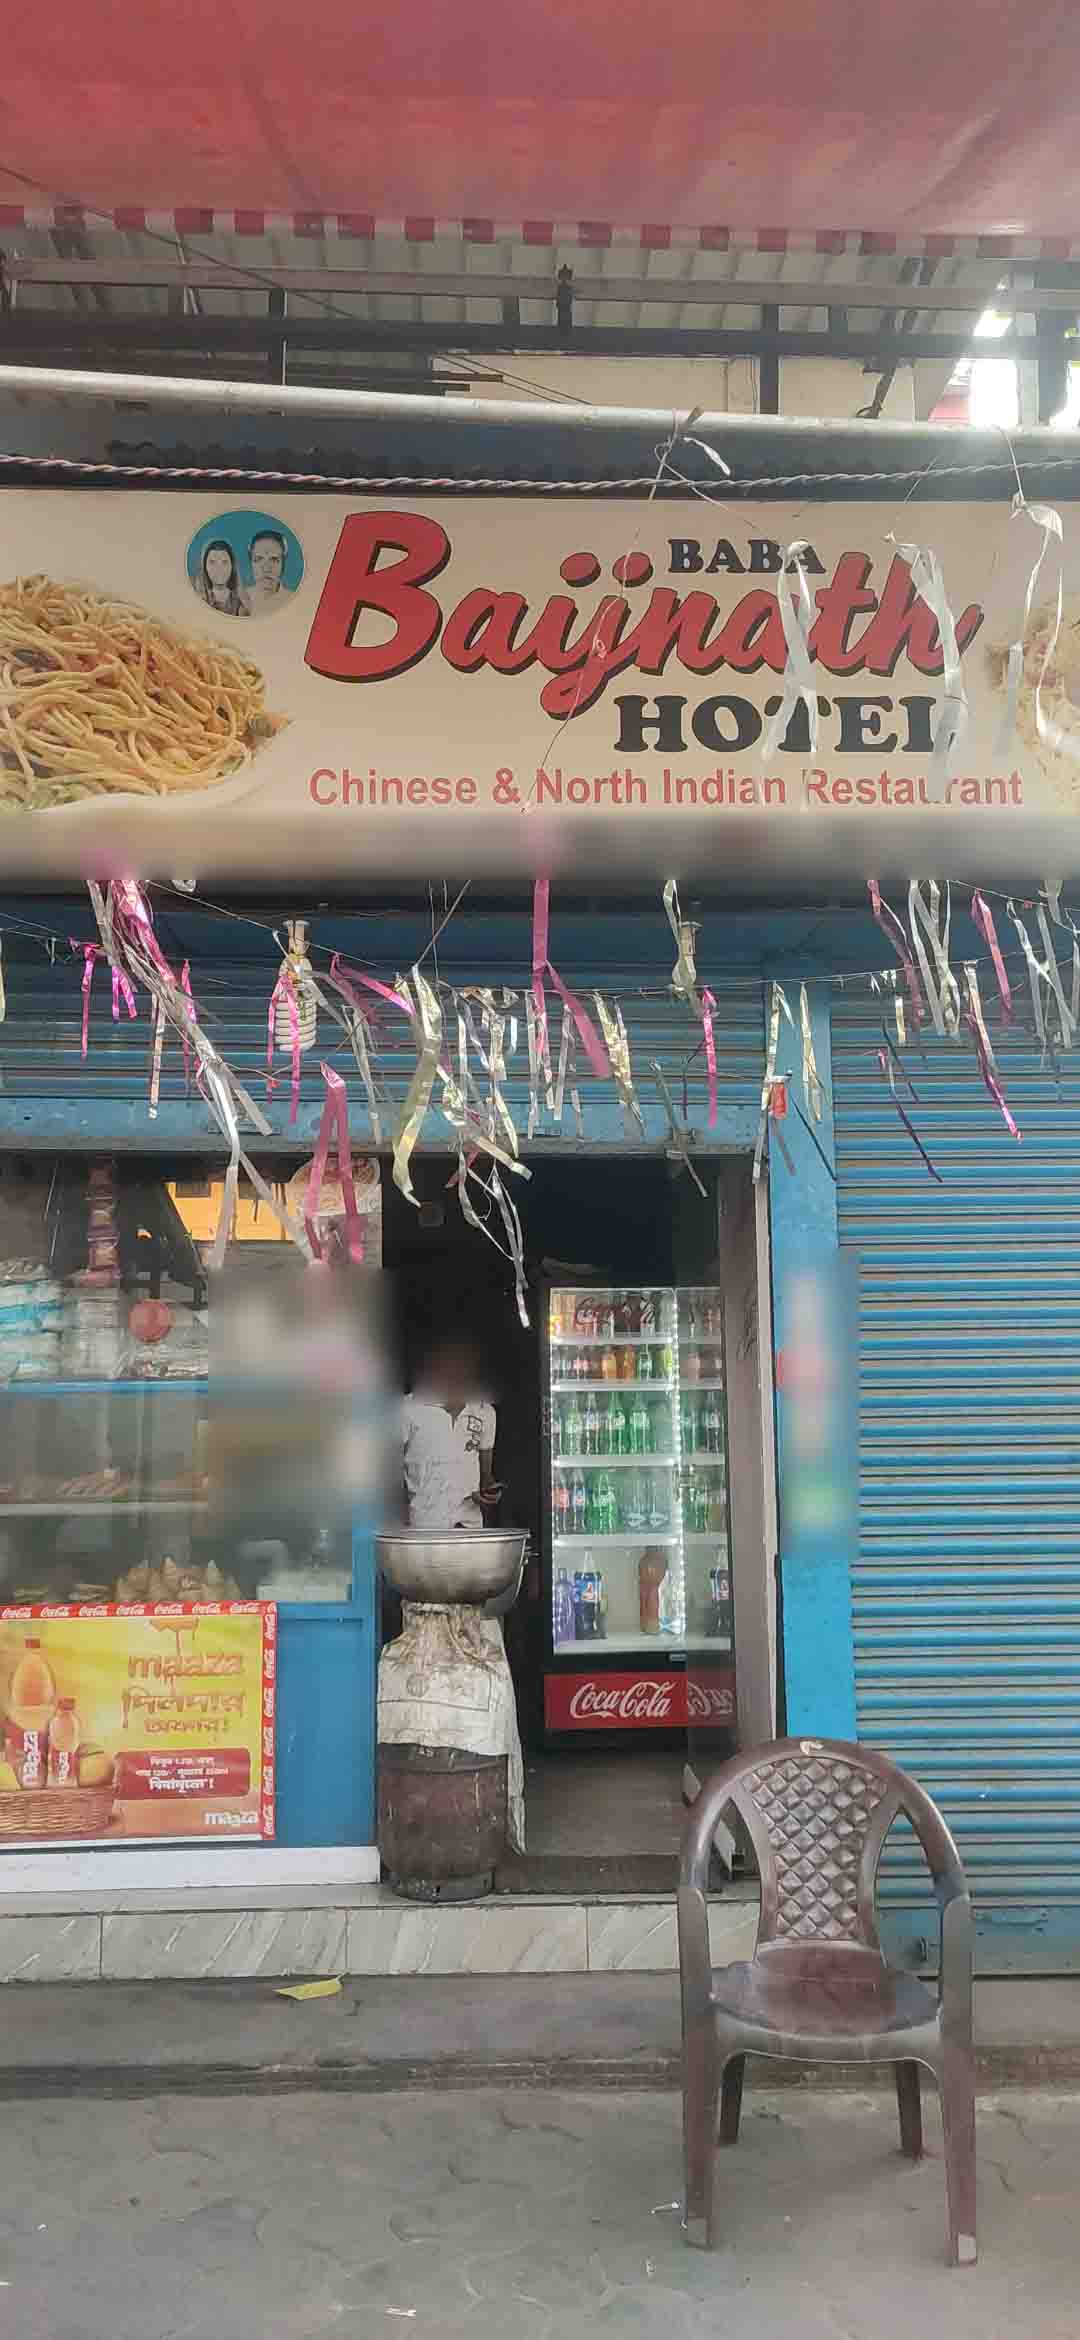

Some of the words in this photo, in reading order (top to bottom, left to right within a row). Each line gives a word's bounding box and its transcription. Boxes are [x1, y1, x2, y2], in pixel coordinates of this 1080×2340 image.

[668, 538, 826, 574] BABA
[304, 510, 985, 721] Baijnath
[309, 768, 478, 805] Chinese
[492, 768, 522, 805] &
[535, 768, 648, 805] North
[662, 768, 786, 805] Indian
[801, 767, 1024, 805] Restaurant
